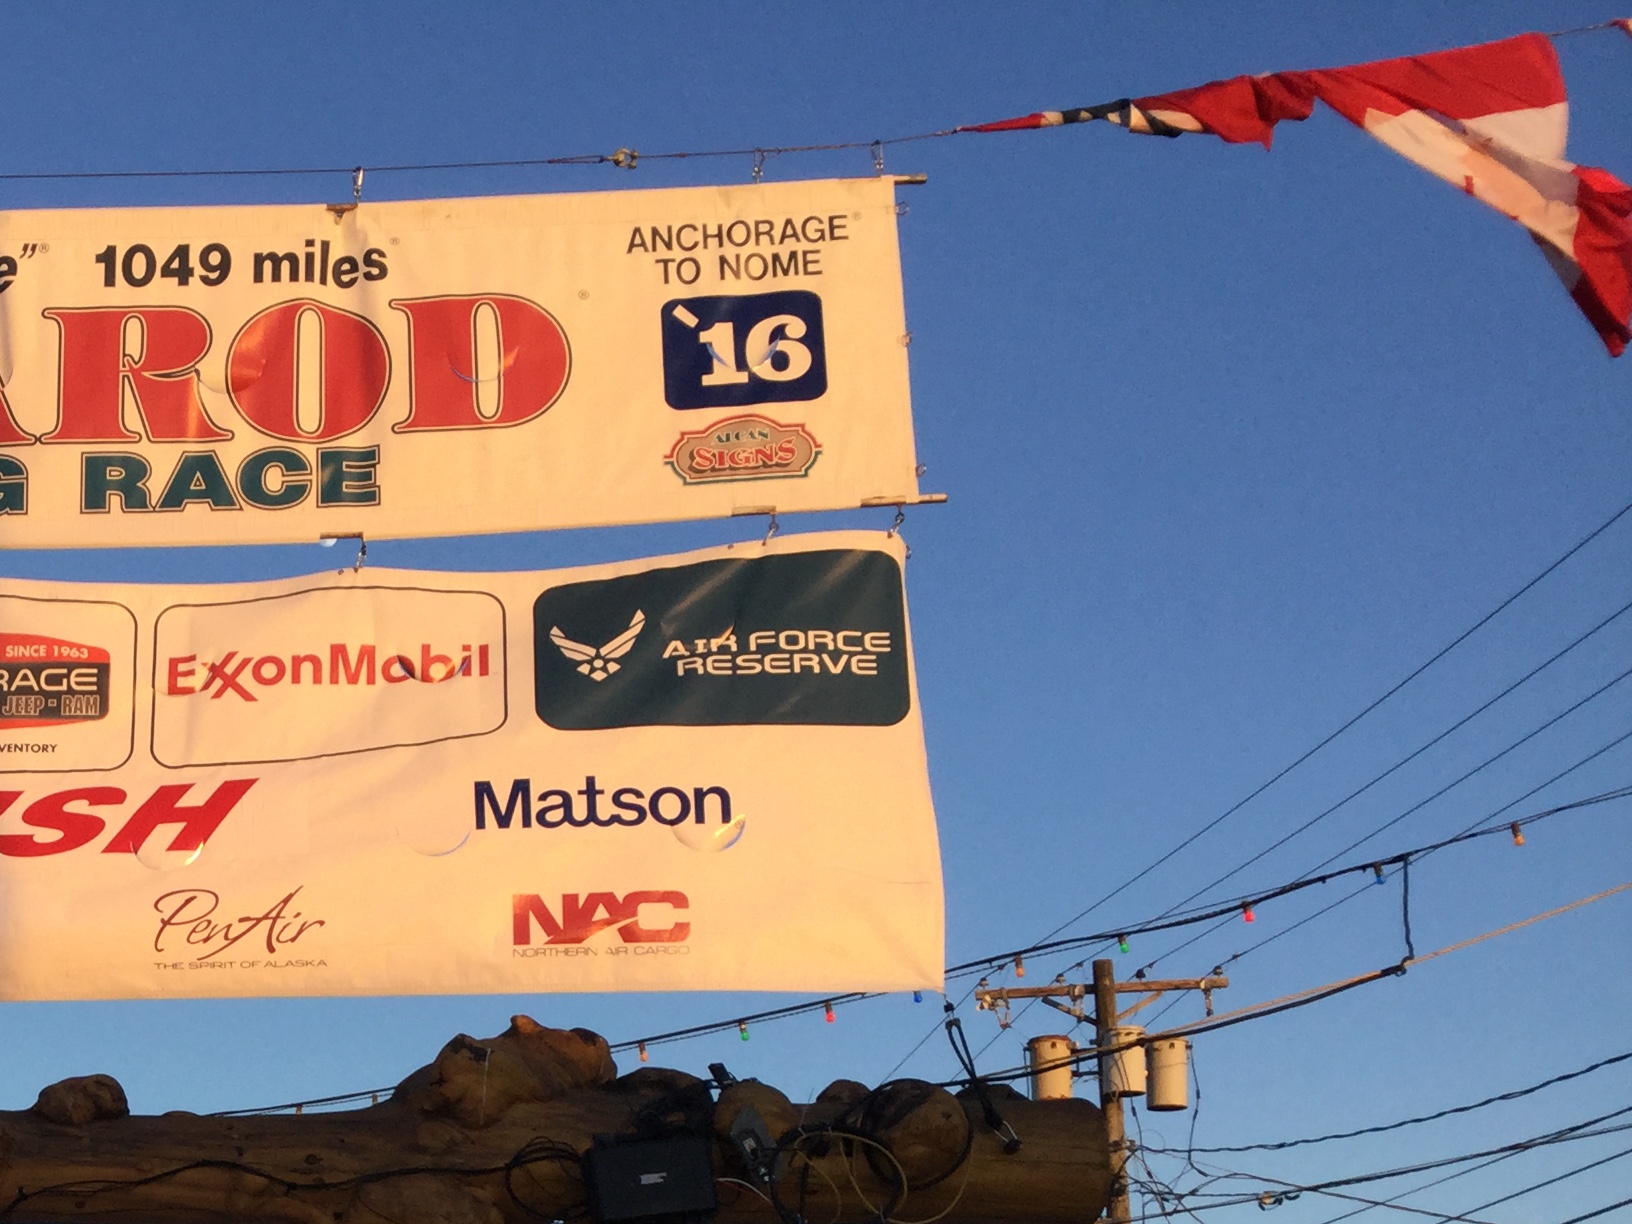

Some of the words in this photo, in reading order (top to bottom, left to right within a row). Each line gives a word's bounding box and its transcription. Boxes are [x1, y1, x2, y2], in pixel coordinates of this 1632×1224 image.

[626, 214, 849, 254] ANCHORAGE
[94, 242, 232, 288] 1049
[252, 238, 388, 290] miles
[655, 257, 701, 285] TO
[719, 250, 823, 281] NOME
[691, 436, 797, 471] SIGNS
[80, 445, 380, 517] RACE
[5, 645, 47, 658] SINCE
[53, 645, 88, 659] 1963
[663, 632, 738, 659] AIR
[748, 628, 891, 654] FORCE
[167, 643, 490, 702] ExxonMobil
[676, 653, 878, 676] RESERVE
[2, 695, 45, 716] JEEP
[61, 695, 100, 716] RAM
[474, 775, 732, 830] Matson
[154, 885, 326, 960] PenAir
[513, 890, 691, 946] NAC
[154, 962, 185, 970] THE
[188, 961, 236, 970] SPIRIT
[240, 960, 261, 969] OF
[264, 959, 327, 969] ALASKA
[513, 947, 598, 958] NORTHERN
[605, 946, 628, 956] AIR
[634, 945, 690, 955] CARGO
